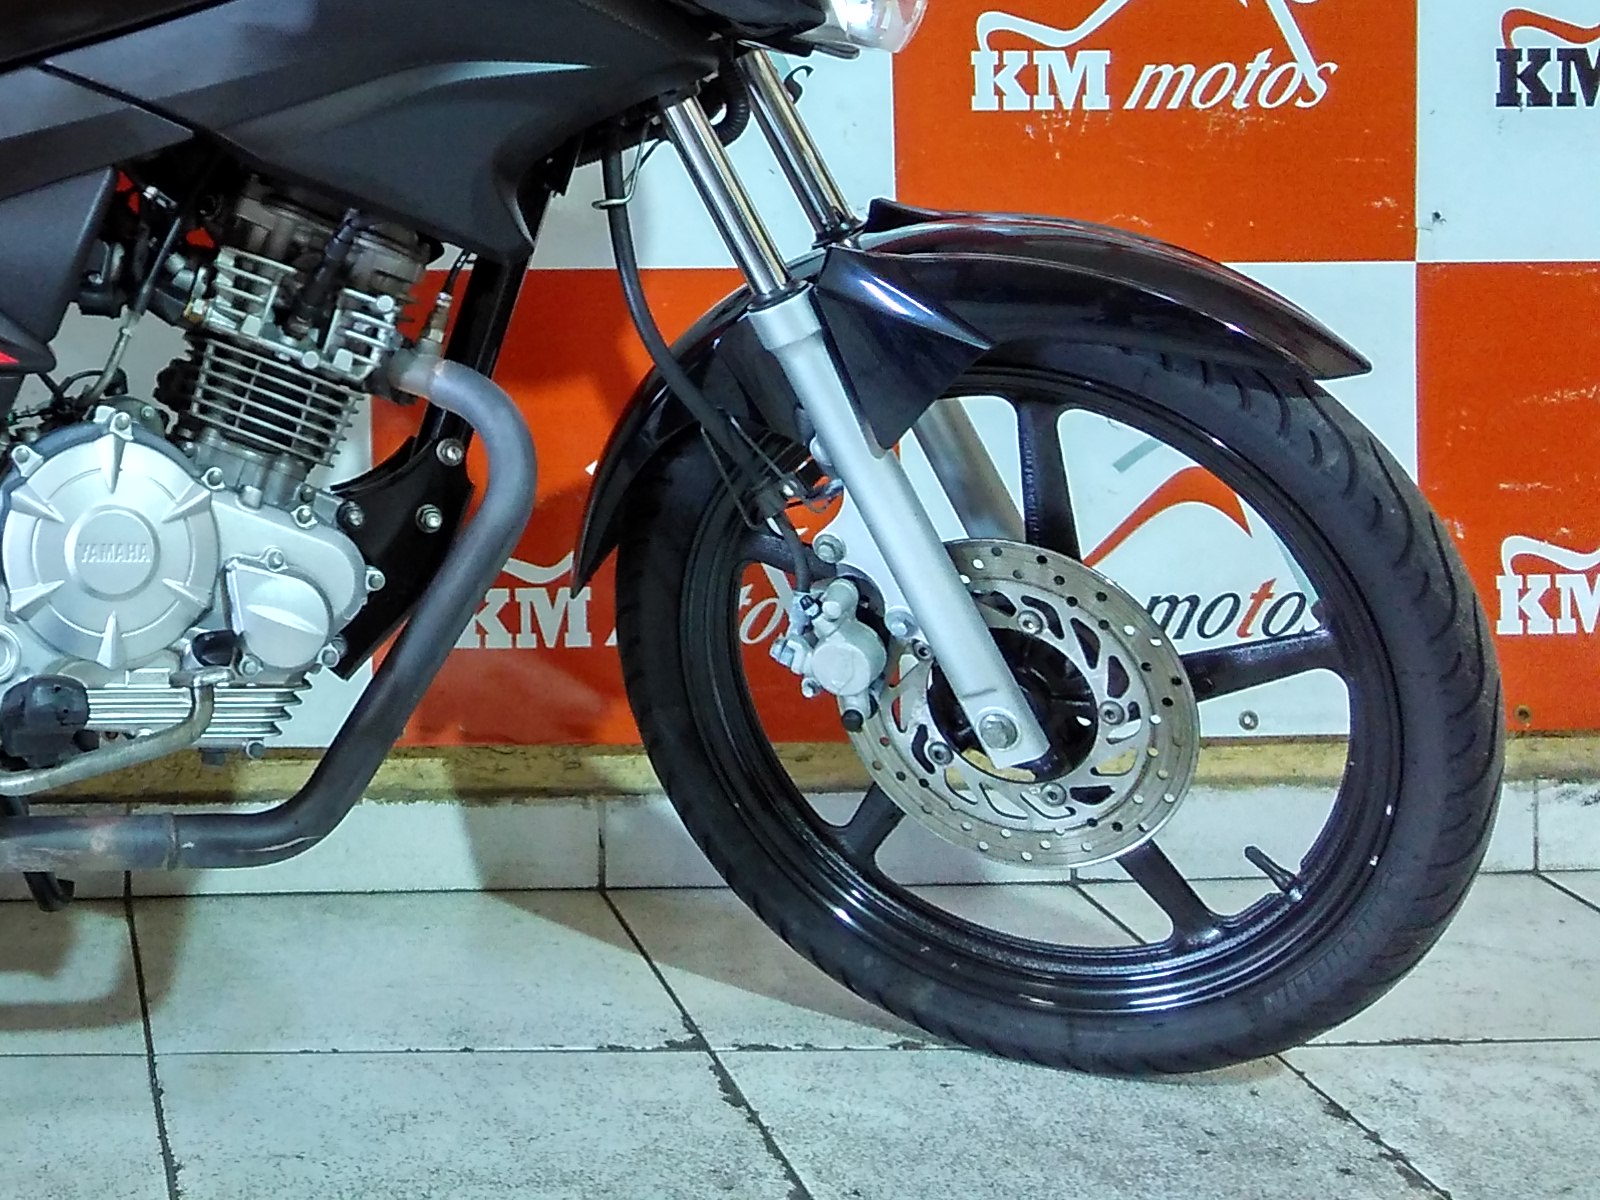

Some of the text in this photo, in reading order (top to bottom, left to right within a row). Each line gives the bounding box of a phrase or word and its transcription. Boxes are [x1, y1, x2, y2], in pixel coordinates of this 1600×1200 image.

[971, 47, 1338, 111] KM motos
[78, 542, 151, 563] YAMAHA
